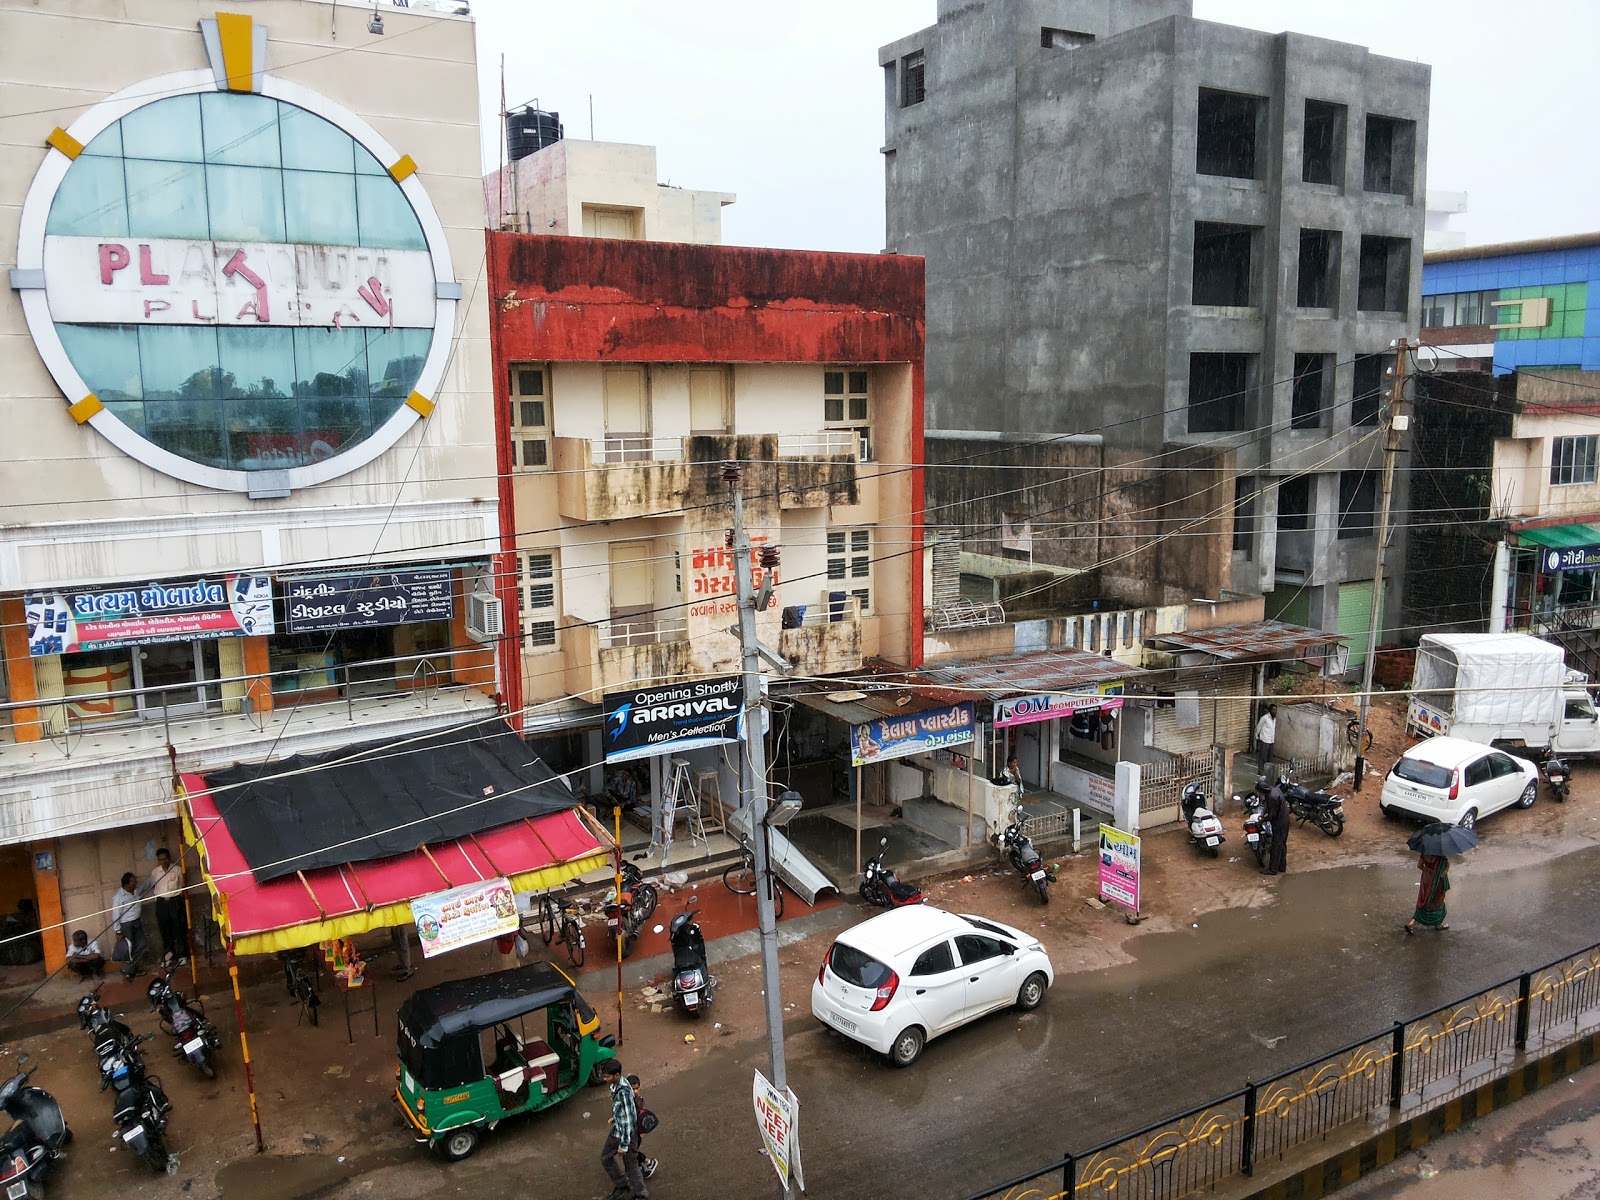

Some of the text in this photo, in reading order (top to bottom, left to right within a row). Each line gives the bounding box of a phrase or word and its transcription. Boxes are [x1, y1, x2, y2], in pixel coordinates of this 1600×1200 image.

[635, 680, 739, 705] Opening Shortly
[1014, 695, 1100, 716] OM COMPUTERS
[647, 723, 726, 743] Men's Collection
[757, 1096, 789, 1136] NEET
[763, 1118, 785, 1146] JEE
